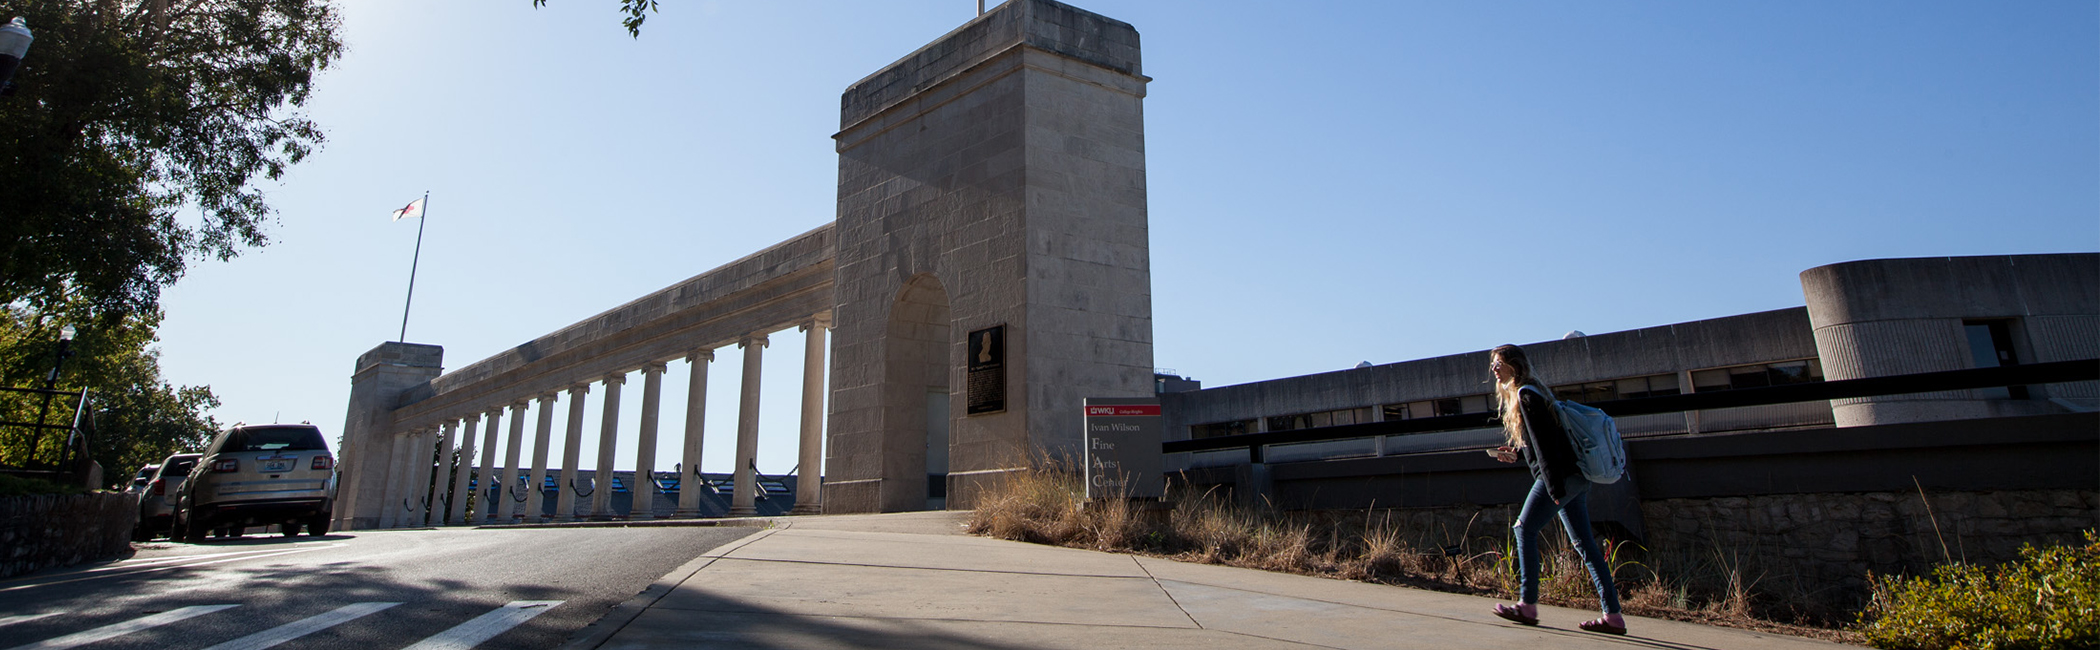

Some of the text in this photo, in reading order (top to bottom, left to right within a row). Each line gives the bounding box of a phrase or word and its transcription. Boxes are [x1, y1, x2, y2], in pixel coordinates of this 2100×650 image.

[1091, 423, 1140, 431] Ivan Wilson
[1092, 438, 1114, 449] Fine
[1092, 456, 1116, 468] Arts
